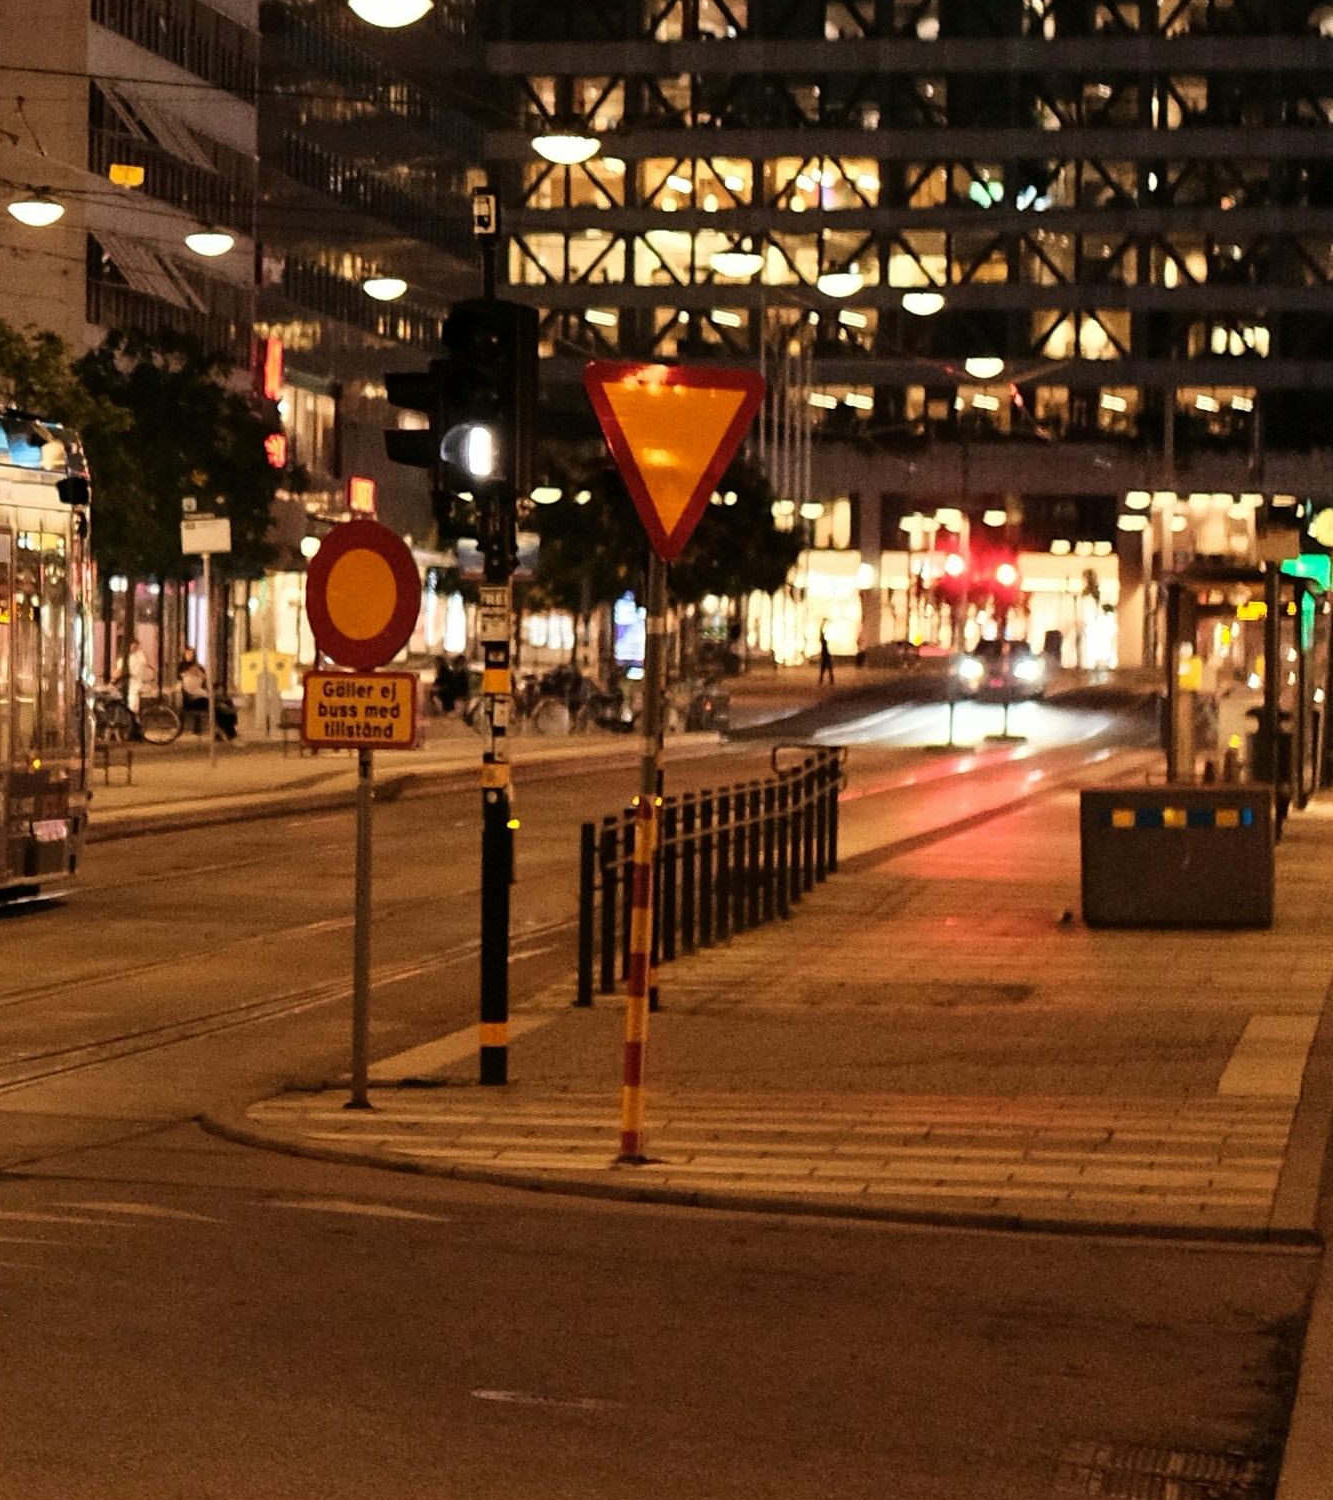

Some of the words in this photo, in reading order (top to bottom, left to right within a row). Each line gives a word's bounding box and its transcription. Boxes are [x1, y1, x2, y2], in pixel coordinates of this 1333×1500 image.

[322, 680, 374, 699] Gäller
[380, 681, 397, 703] ej
[318, 701, 358, 718] buss
[364, 701, 401, 719] med
[324, 721, 394, 738] tillstånd
